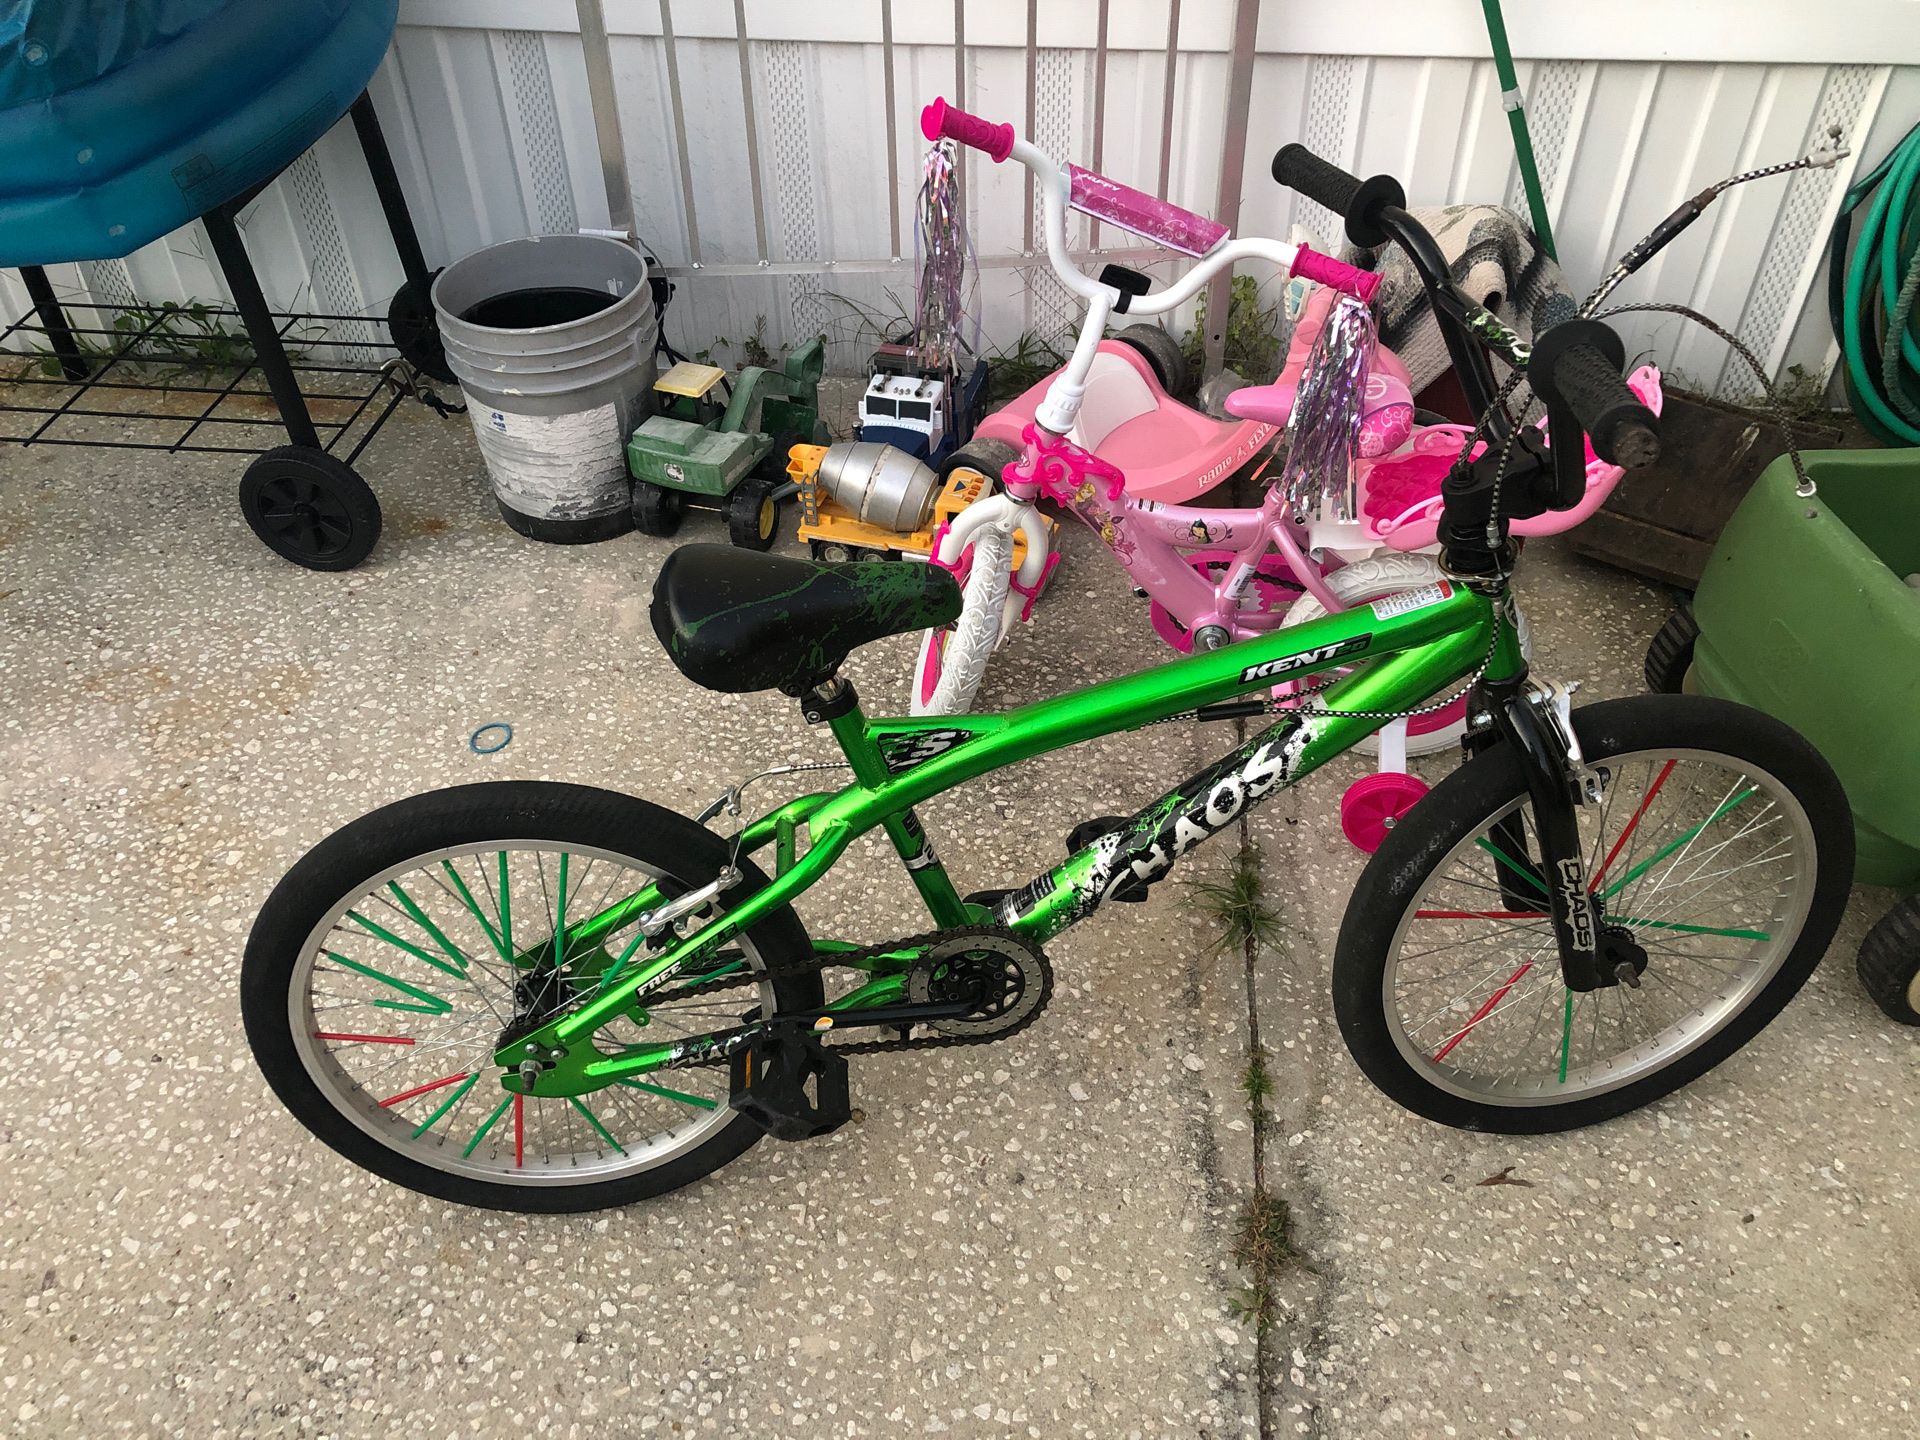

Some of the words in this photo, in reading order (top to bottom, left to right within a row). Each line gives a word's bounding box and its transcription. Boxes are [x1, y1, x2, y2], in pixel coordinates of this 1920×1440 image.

[1197, 455, 1233, 489] RADIO
[1243, 642, 1346, 683] KENT
[1563, 861, 1594, 949] CHAOS
